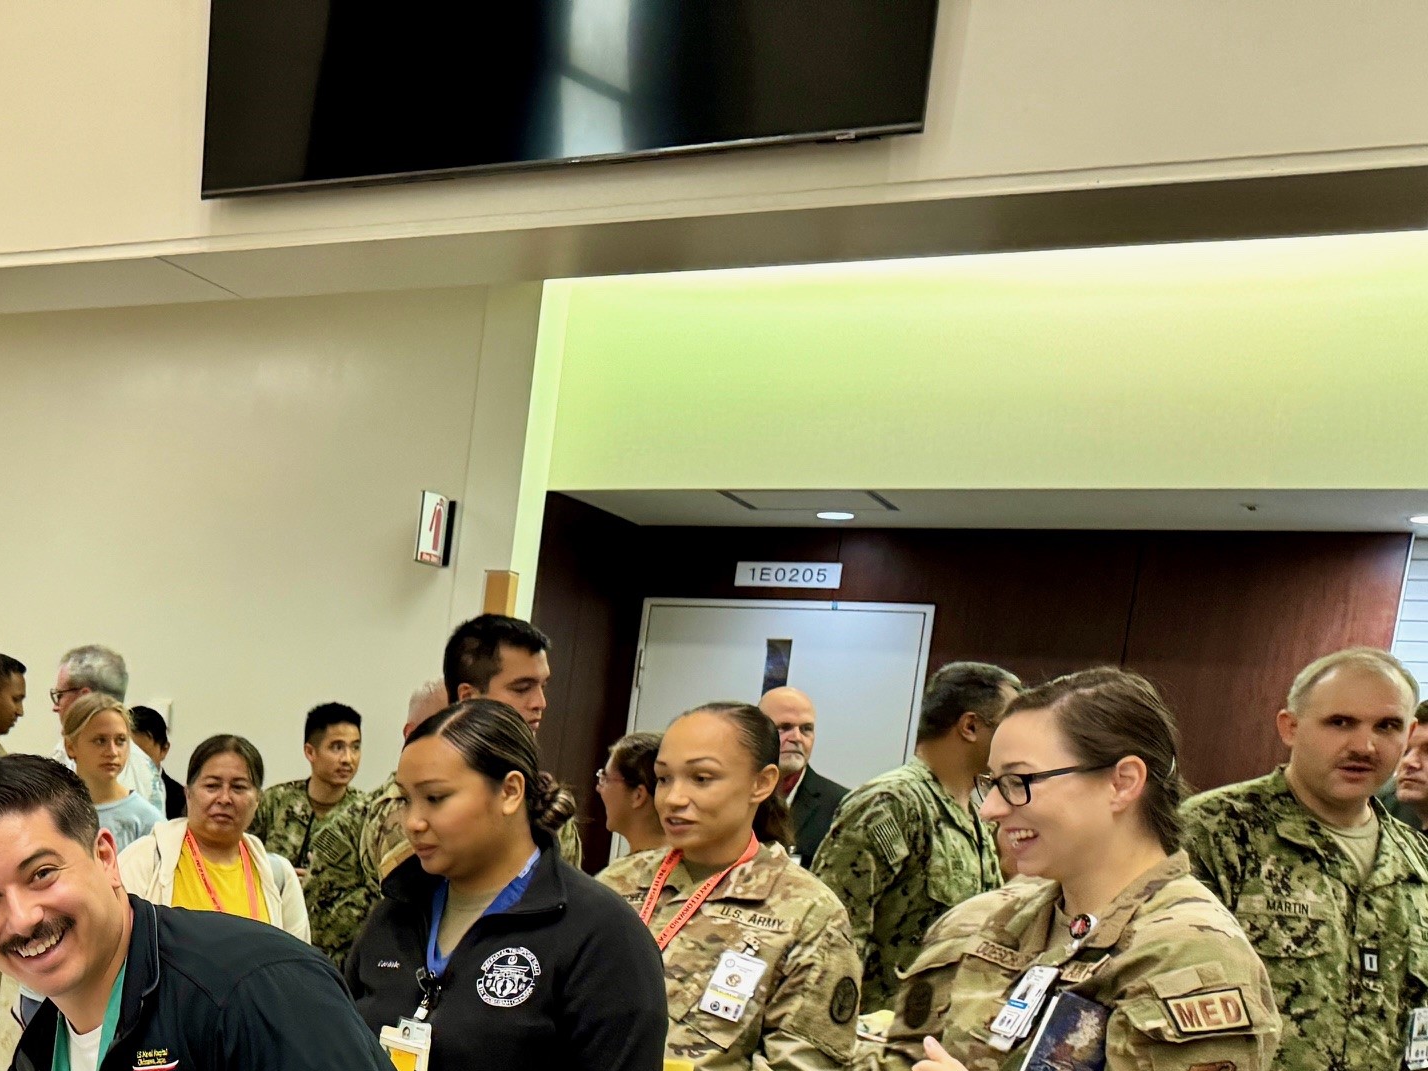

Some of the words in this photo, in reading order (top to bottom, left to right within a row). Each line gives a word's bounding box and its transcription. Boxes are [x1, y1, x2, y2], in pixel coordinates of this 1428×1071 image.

[749, 567, 828, 583] 1E0205
[720, 906, 742, 921] U.S.
[747, 913, 785, 928] ARMY
[1266, 900, 1309, 915] MARTIN
[1173, 995, 1242, 1028] MED
